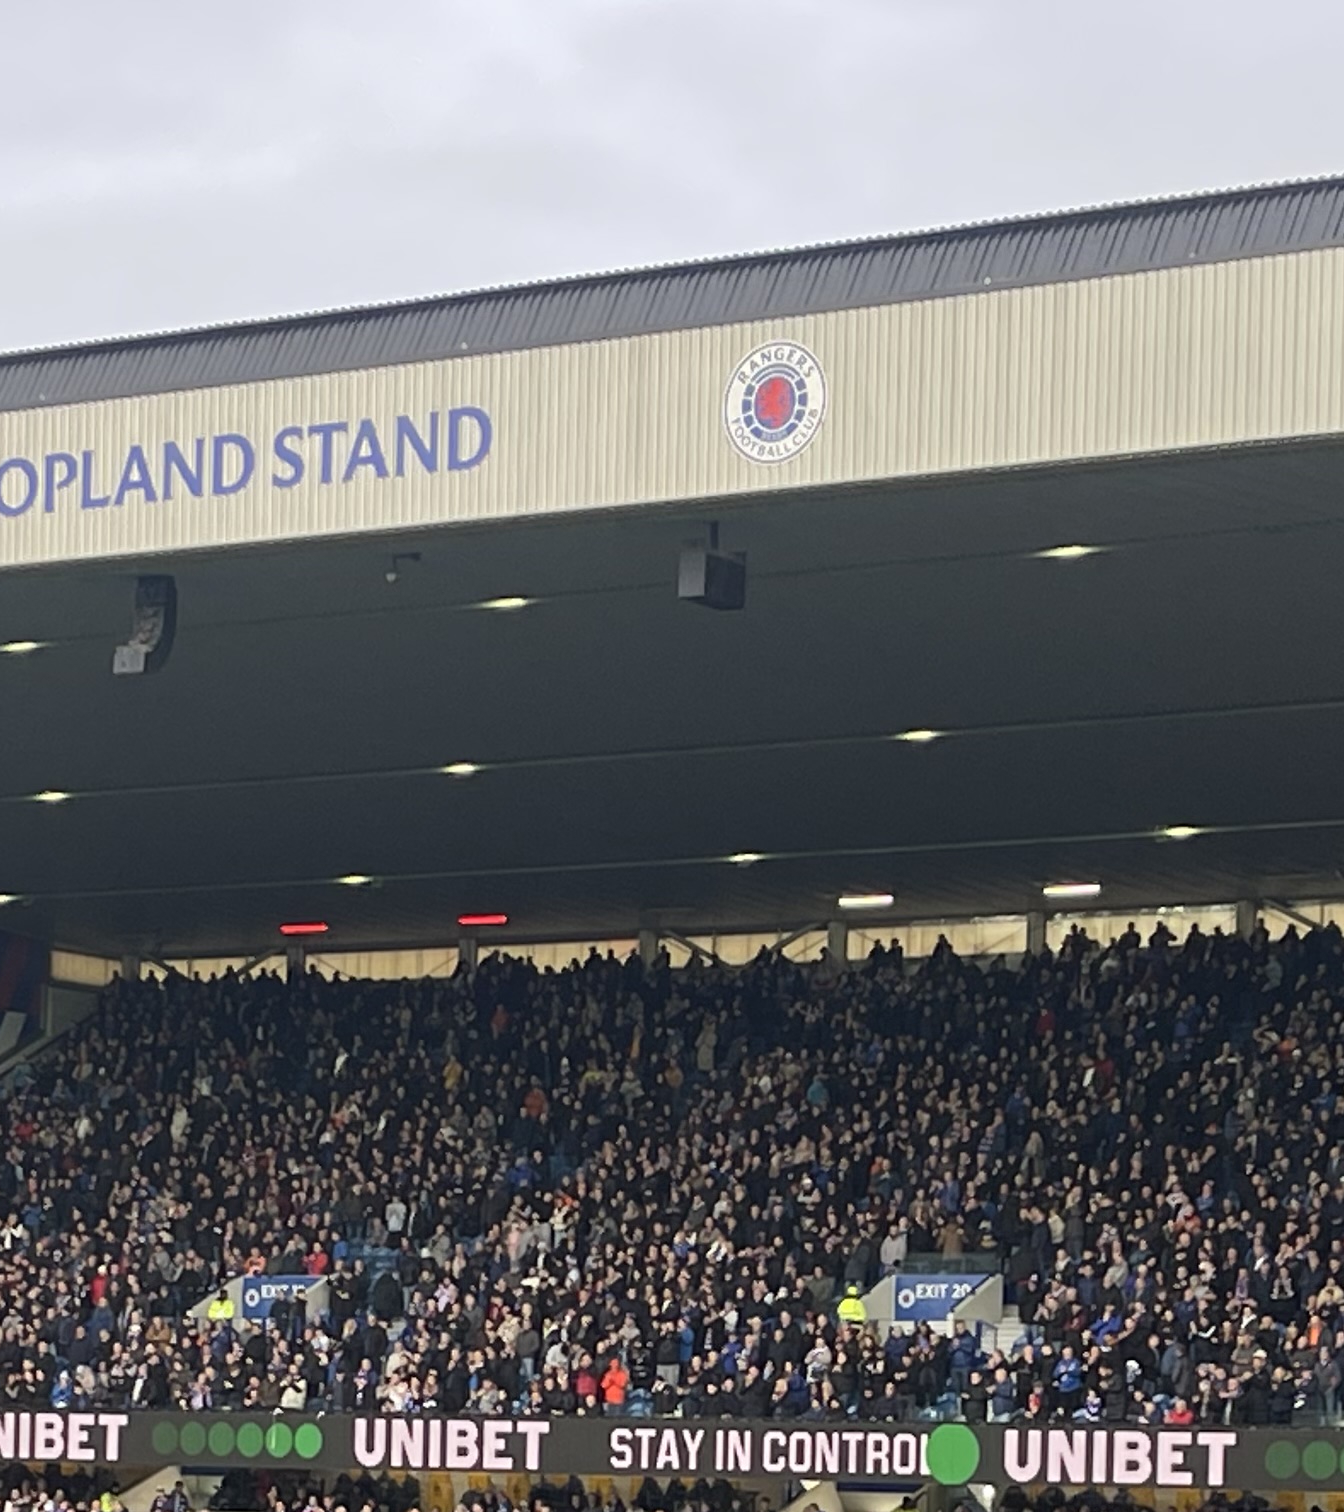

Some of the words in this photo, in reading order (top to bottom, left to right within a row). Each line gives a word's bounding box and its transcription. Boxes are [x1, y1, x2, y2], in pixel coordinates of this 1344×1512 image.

[738, 347, 815, 384] RANGERS
[271, 406, 493, 488] STAND
[730, 417, 792, 457] FOOTBALL
[793, 408, 819, 446] CLUB
[916, 1283, 949, 1299] EXIT
[353, 1418, 550, 1471] UNIBET
[610, 1428, 704, 1471] STAY
[715, 1430, 752, 1472] IN
[1004, 1430, 1237, 1486] UNIBET
